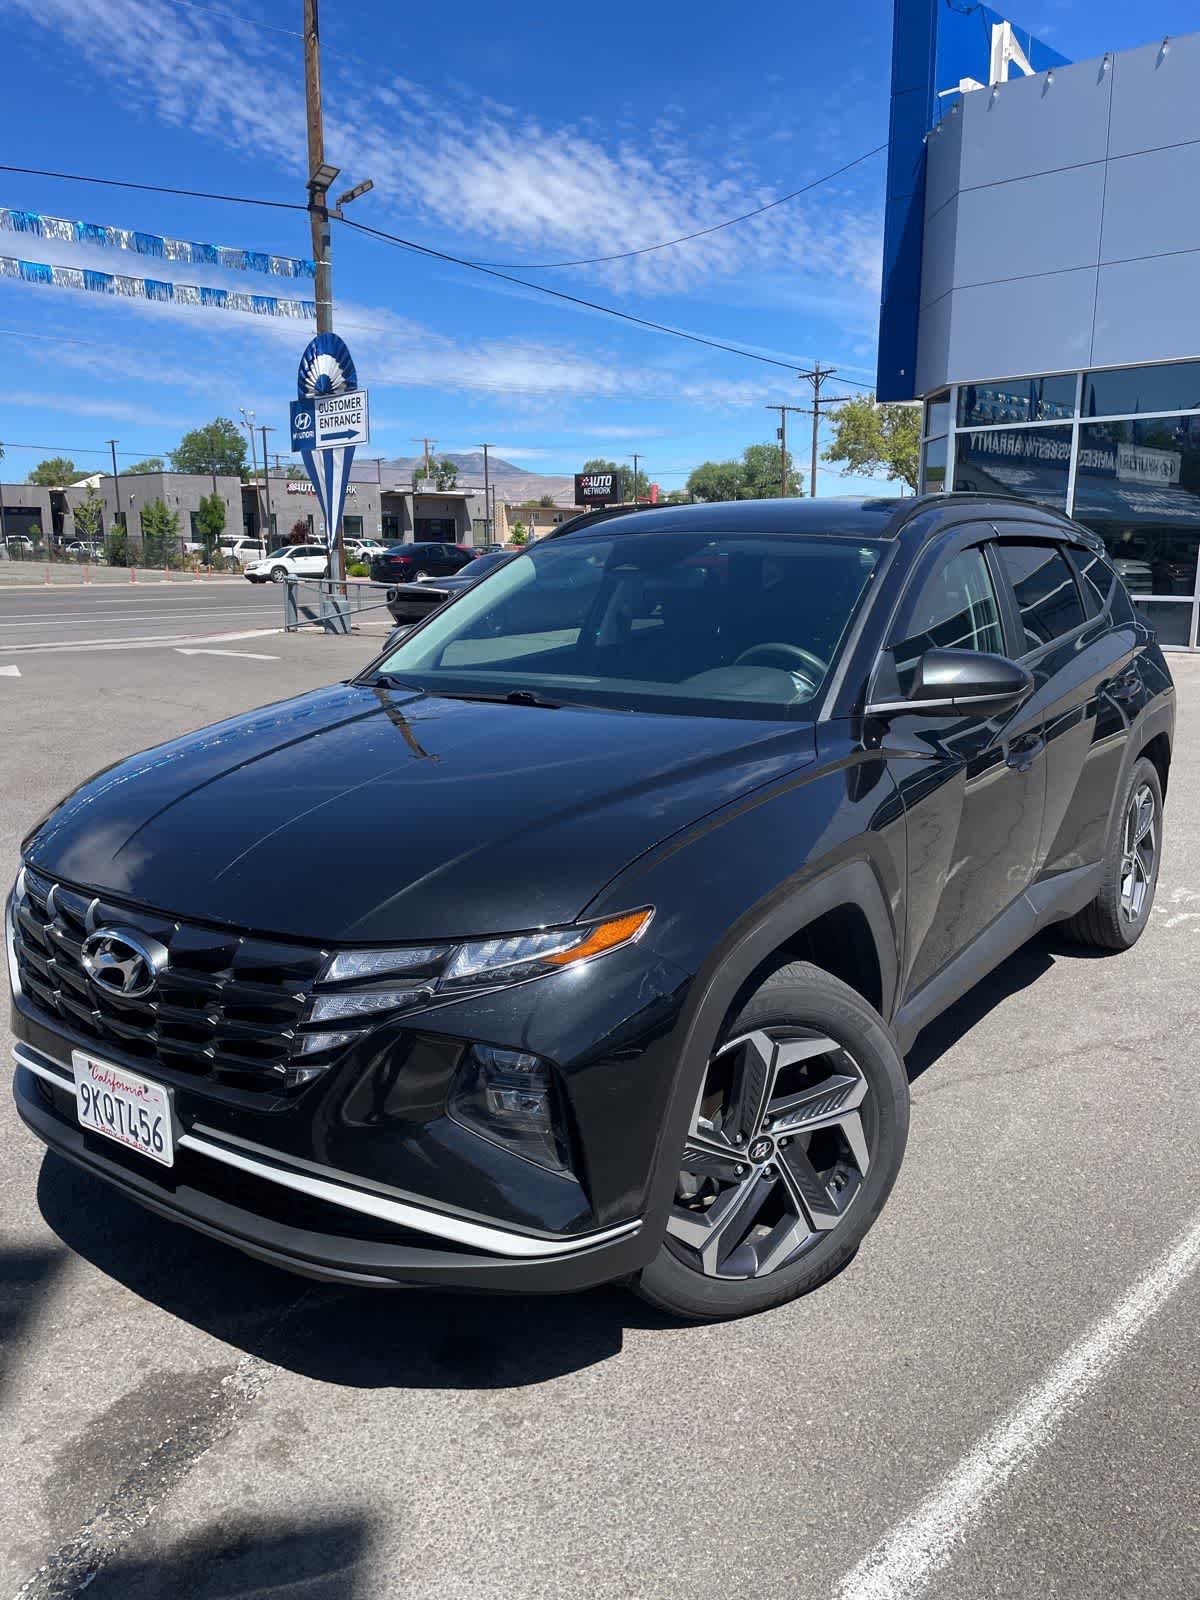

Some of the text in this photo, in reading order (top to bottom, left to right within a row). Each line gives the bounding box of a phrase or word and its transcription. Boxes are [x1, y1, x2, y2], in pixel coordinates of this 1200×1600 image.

[318, 397, 361, 414] CUSTOMER
[319, 412, 361, 429] ENTRANCE
[589, 475, 612, 487] AUTO
[583, 486, 611, 495] NETWORK
[91, 1064, 147, 1100] California
[80, 1083, 163, 1153] 9KQT456
